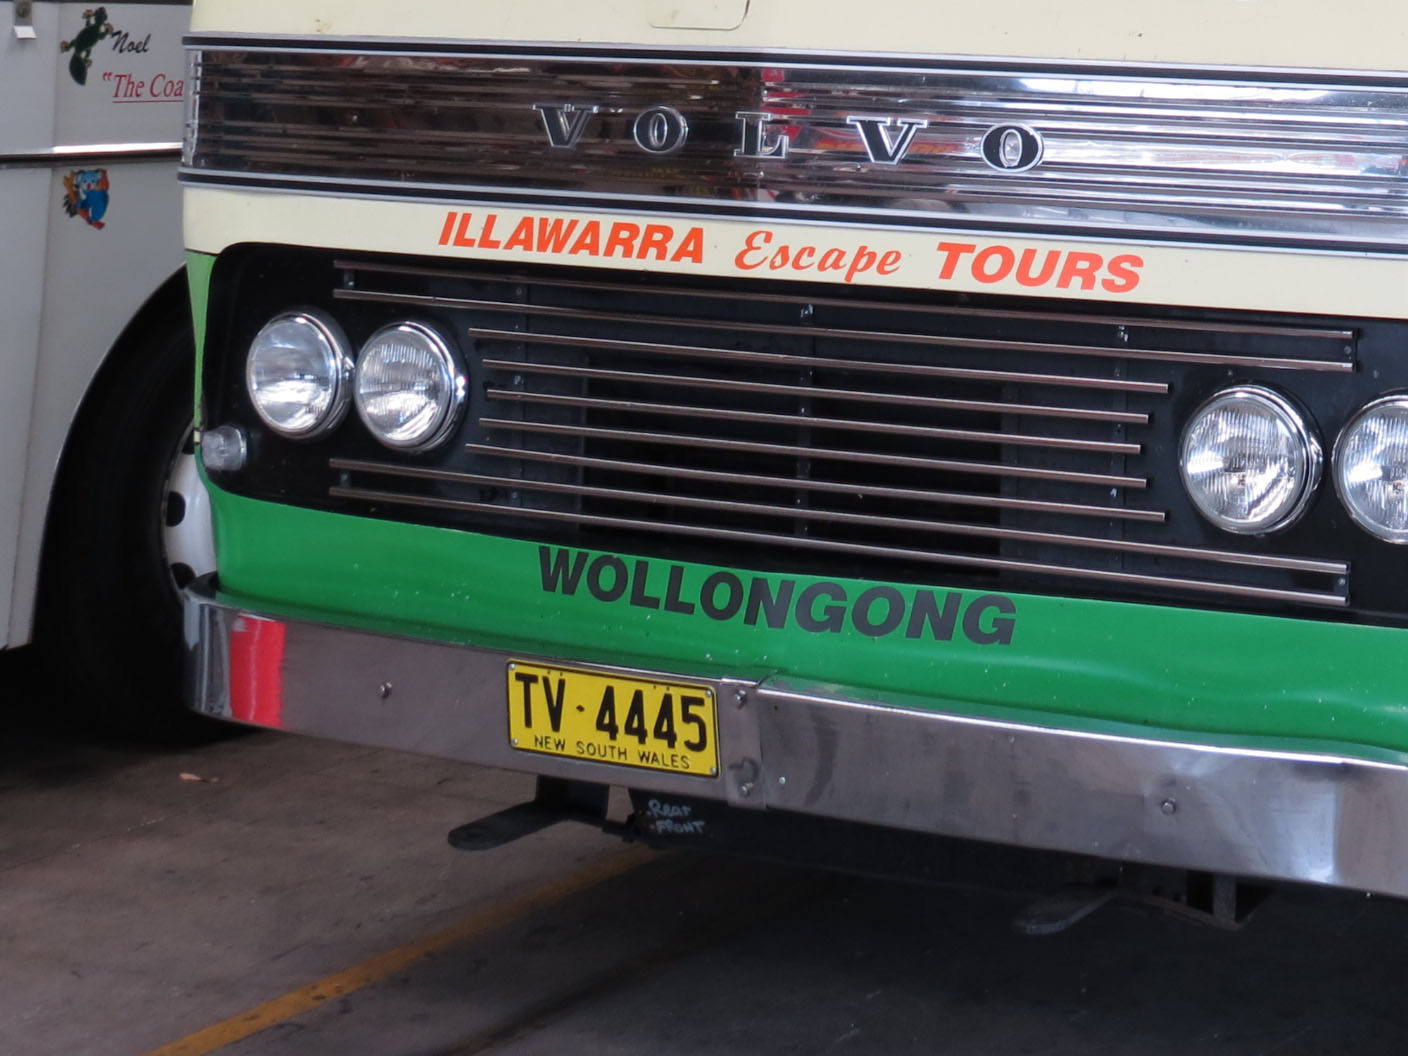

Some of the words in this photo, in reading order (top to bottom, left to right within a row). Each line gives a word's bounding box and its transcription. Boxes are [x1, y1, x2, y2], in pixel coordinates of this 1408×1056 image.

[110, 30, 152, 54] Noel
[532, 103, 1045, 174] VOLVO
[437, 211, 706, 265] ILLAWARRA
[733, 230, 902, 283] Escape
[935, 242, 1145, 294] TOURS
[538, 545, 1018, 646] WOLLONGONG
[533, 735, 566, 751] NEW
[576, 741, 628, 761] SOUTH
[639, 751, 690, 770] WALES
